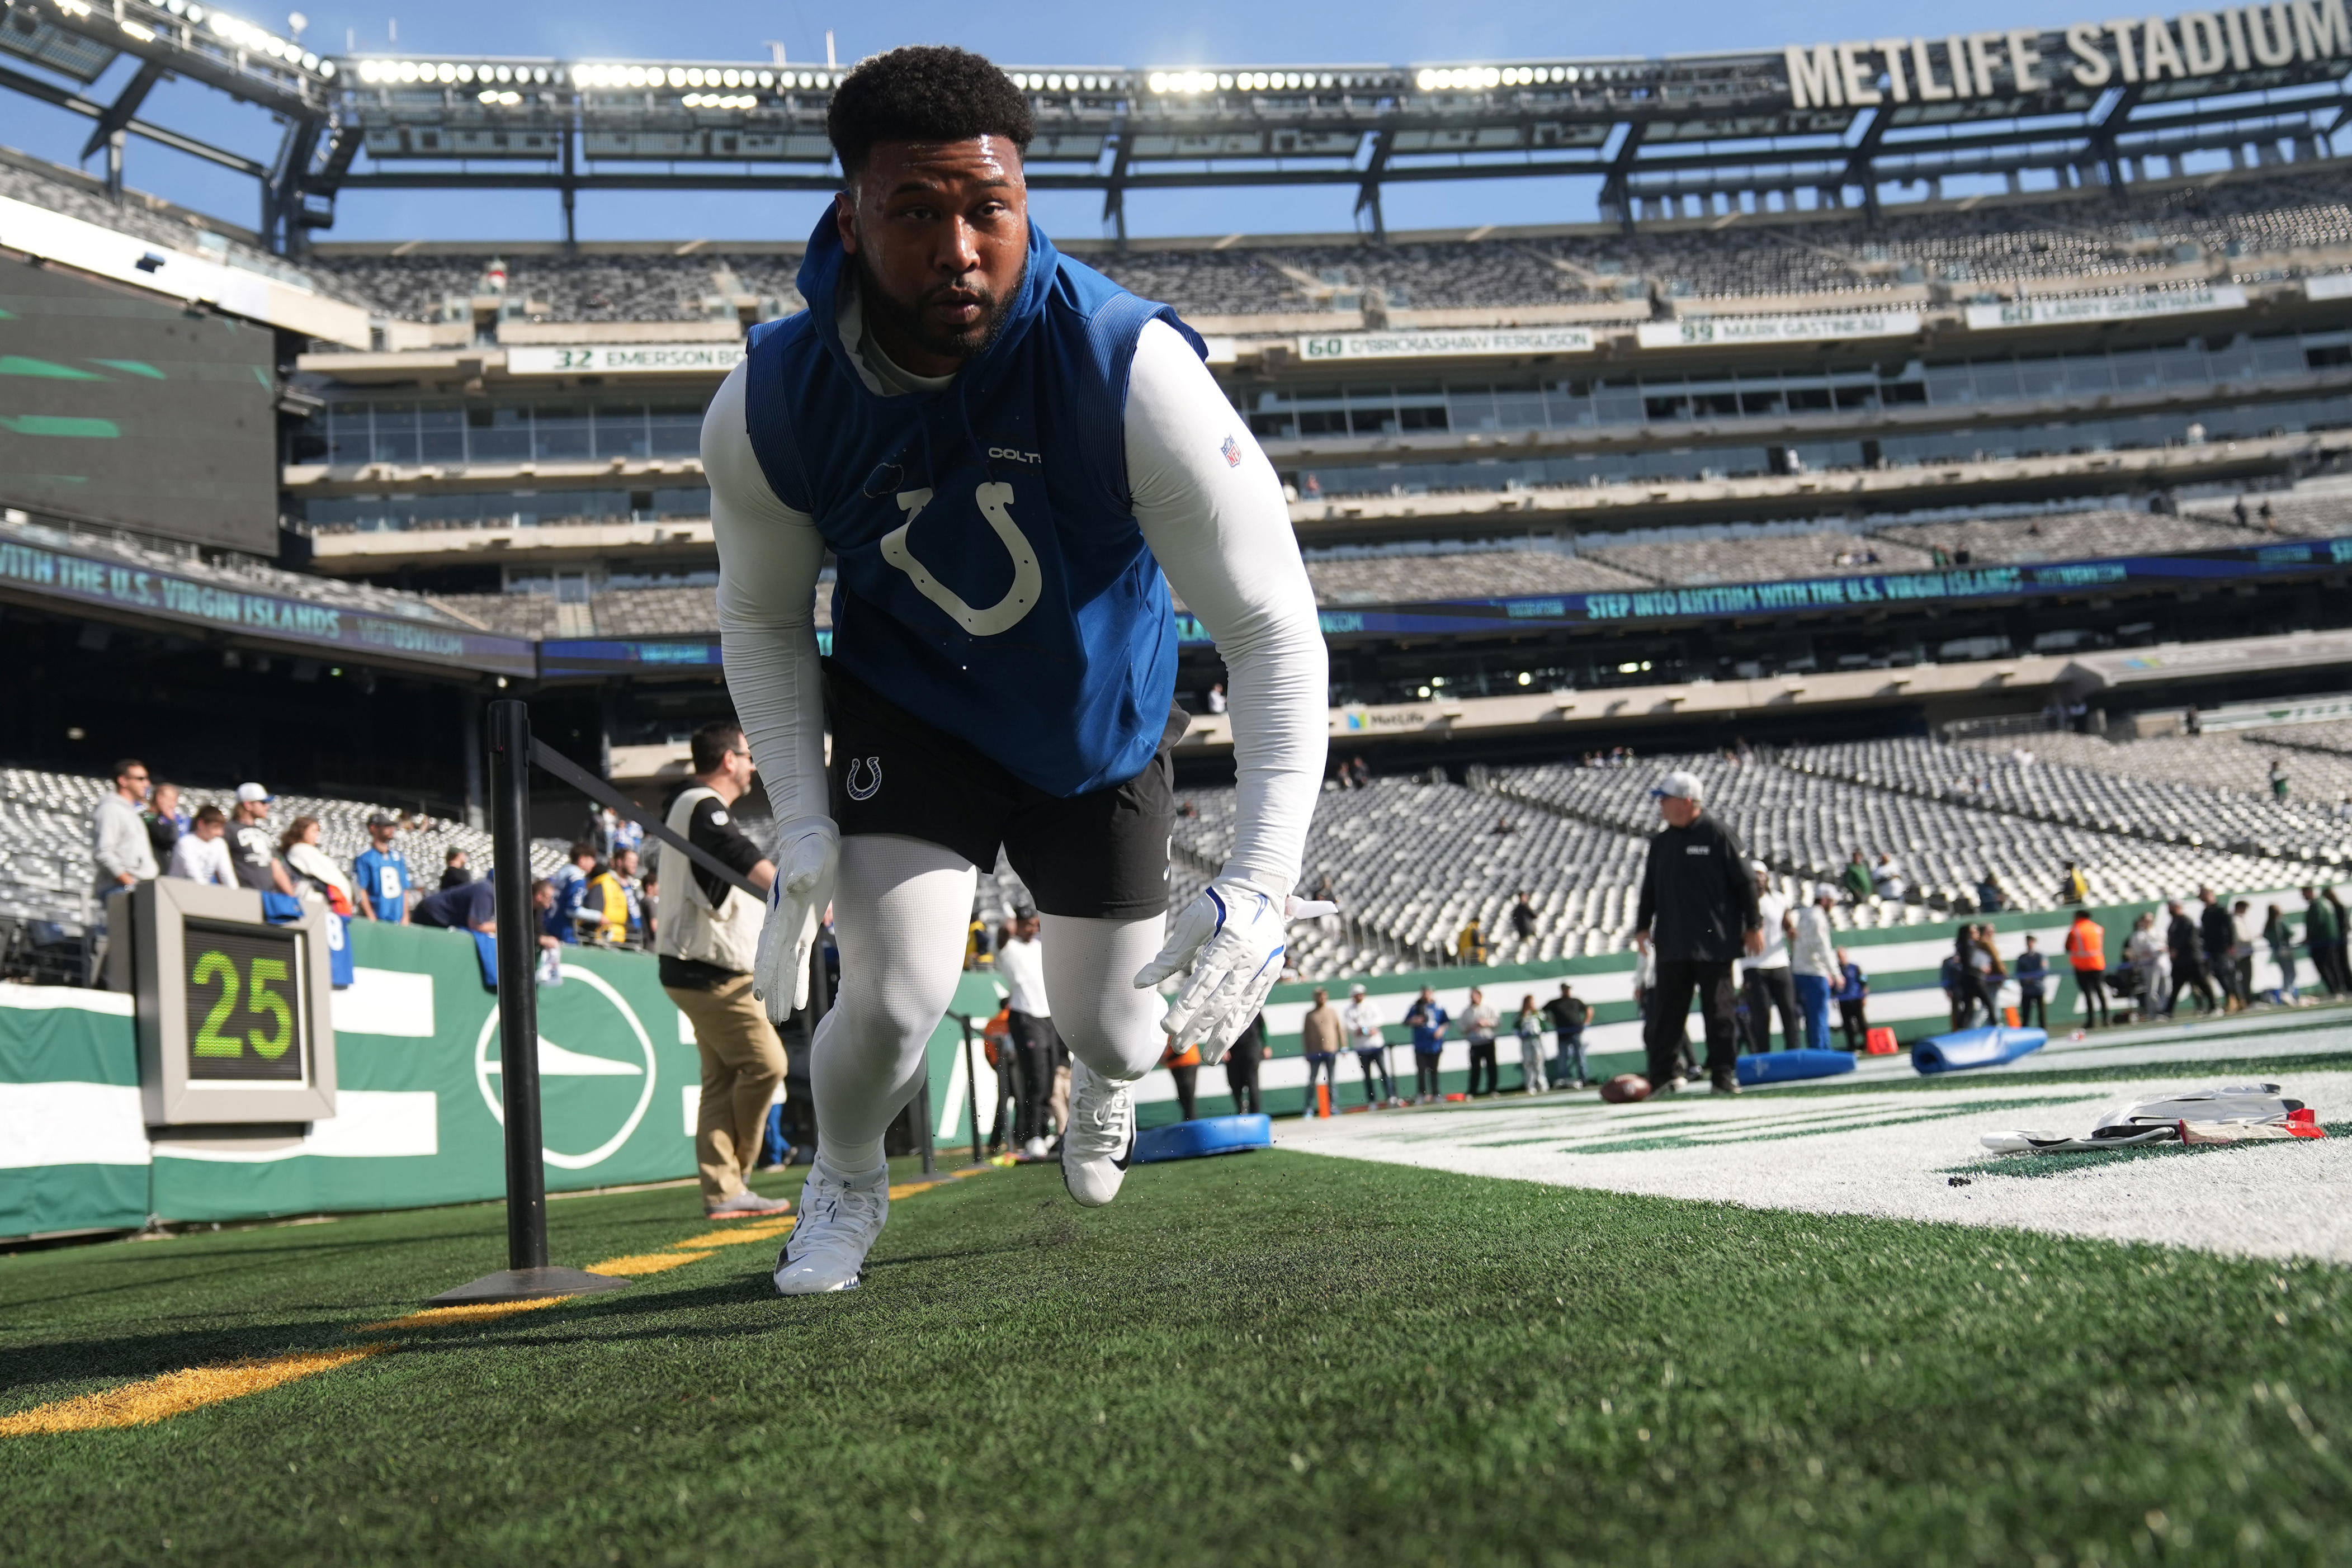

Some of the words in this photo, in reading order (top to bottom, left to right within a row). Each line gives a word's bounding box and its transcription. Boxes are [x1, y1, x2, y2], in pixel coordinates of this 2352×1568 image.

[1785, 28, 2049, 108] METLIFE
[2065, 0, 2350, 86] STADIUM
[1680, 322, 1714, 343] 99
[1723, 320, 1778, 337] MARK
[1307, 338, 1342, 356] 60
[1494, 332, 1588, 348] FERGUSON
[554, 348, 593, 370] 32
[606, 350, 712, 367] EMERSON
[718, 350, 747, 364] BO
[988, 447, 1041, 464] COLT
[58, 556, 106, 596] THE
[111, 567, 158, 607] U.S.
[161, 577, 240, 622] VIRGIN
[243, 595, 341, 640] ISLANDS
[1586, 594, 1631, 619] STEP
[1633, 591, 1678, 617] INTO
[1680, 585, 1756, 614] RHYTHM
[1756, 582, 1810, 608] WITH
[1810, 579, 1845, 604] THE
[1846, 577, 1883, 602] U.S.
[1884, 573, 1947, 599] VIRGIN
[1371, 714, 1424, 725] MetLife
[192, 950, 293, 1060] 25
